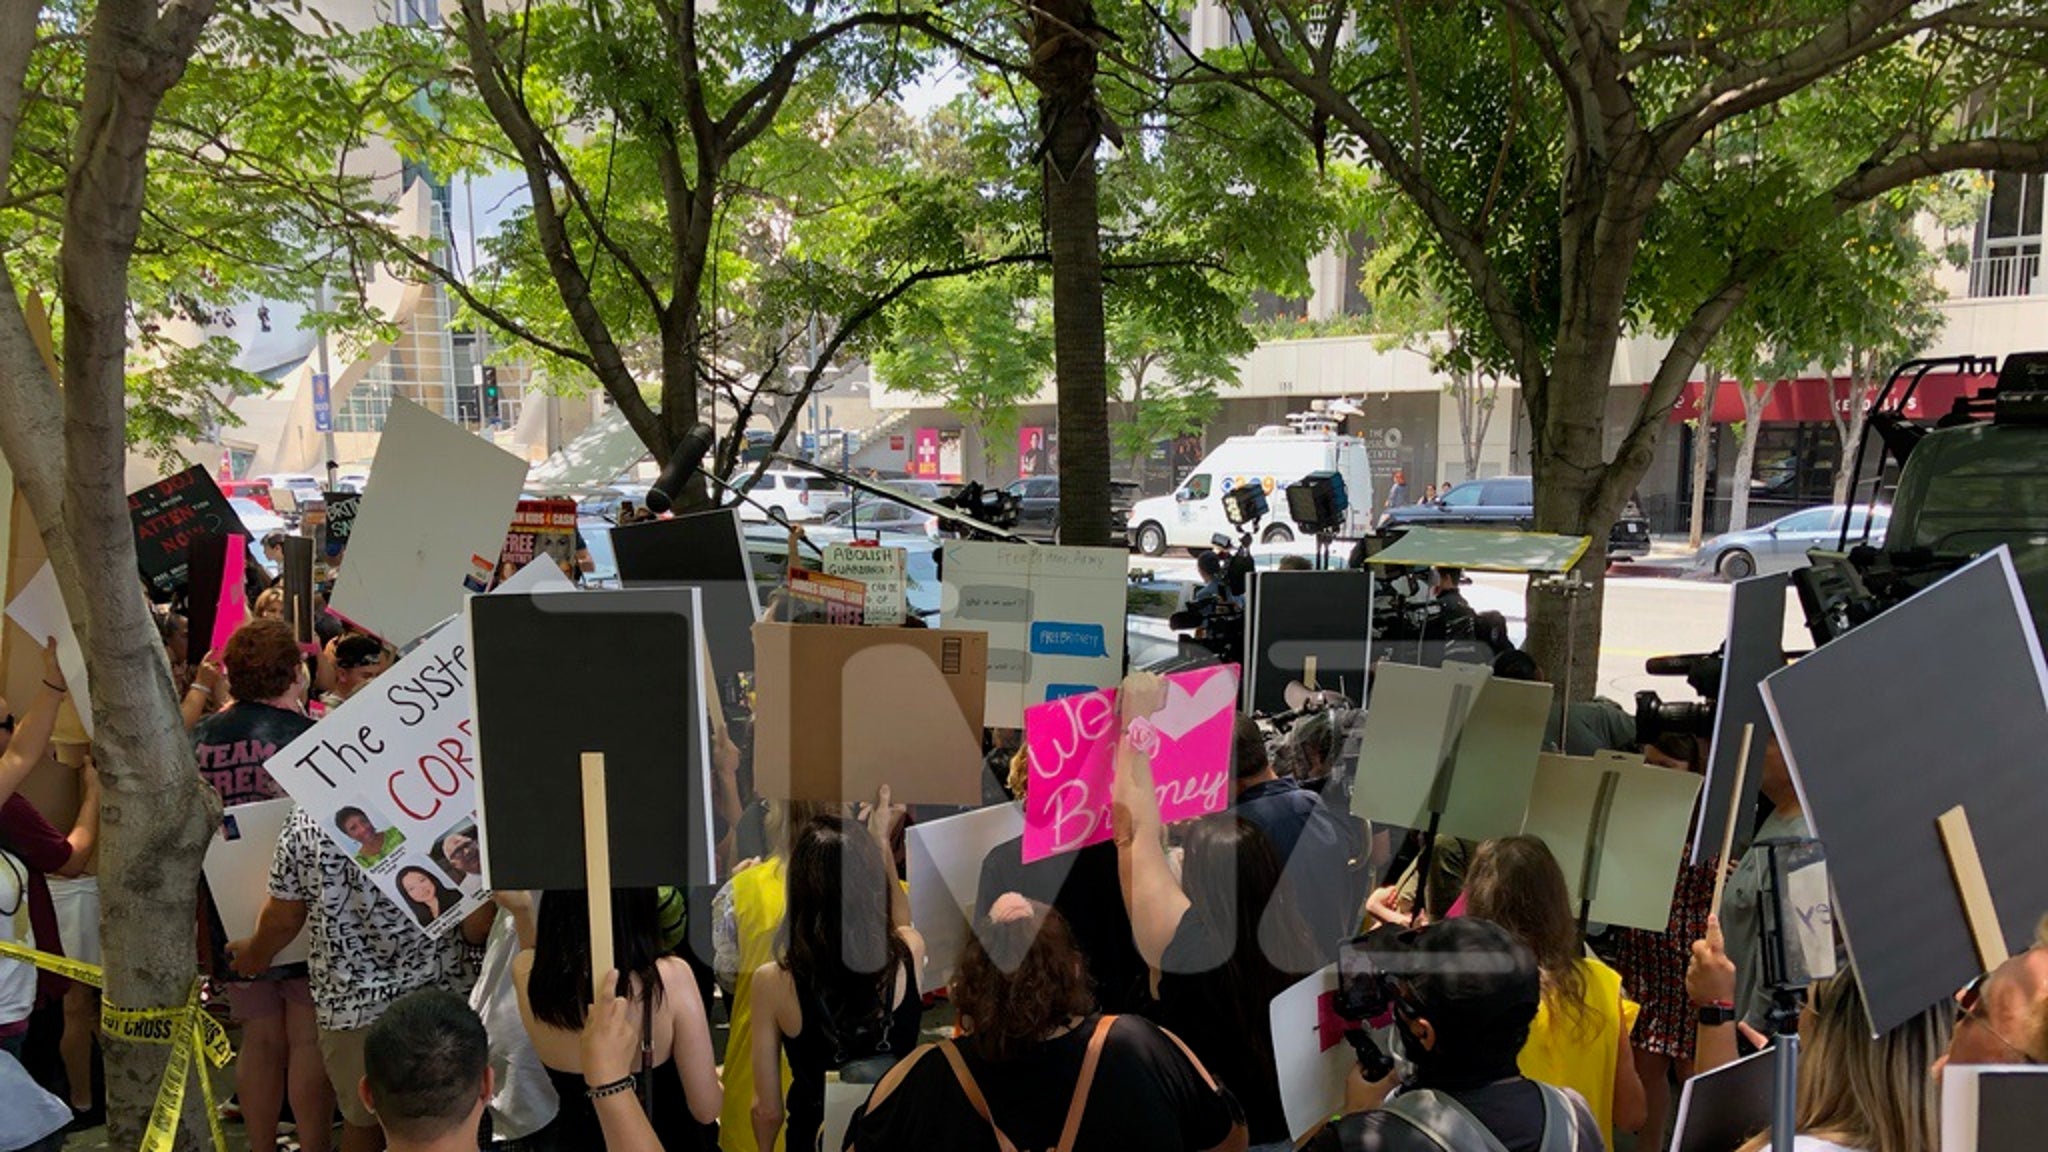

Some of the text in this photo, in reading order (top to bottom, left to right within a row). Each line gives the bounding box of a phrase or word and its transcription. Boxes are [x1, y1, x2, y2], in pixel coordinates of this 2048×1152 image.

[504, 534, 535, 552] FREE
[833, 547, 892, 561] ABOLISH
[294, 645, 469, 790] The Syste
[1028, 691, 1113, 779] We
[196, 739, 278, 768] TEAM
[1043, 770, 1229, 852] Brney
[123, 1019, 173, 1040] CROSS
